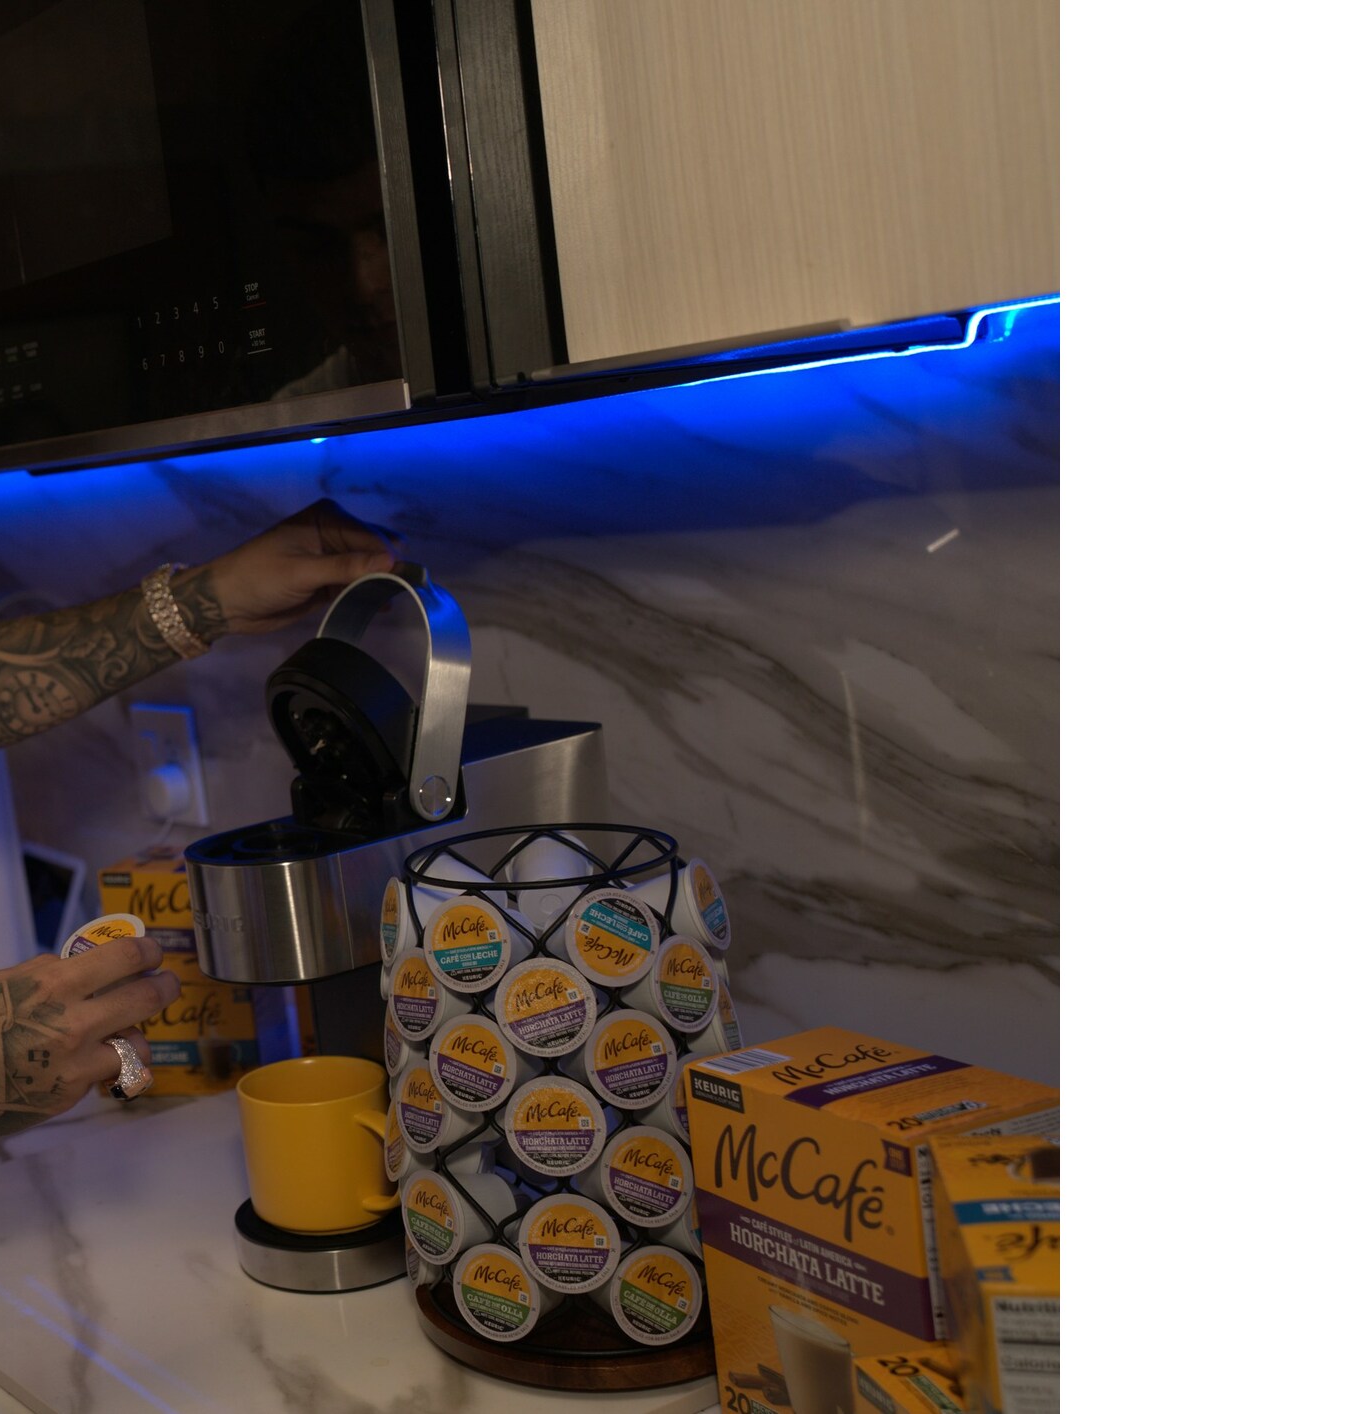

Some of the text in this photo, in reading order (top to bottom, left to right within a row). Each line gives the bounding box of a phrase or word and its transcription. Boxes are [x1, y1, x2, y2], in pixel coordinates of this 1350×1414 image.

[244, 282, 258, 293] STOP
[137, 296, 219, 328] 1 2 3 4 5
[249, 328, 265, 339] START
[142, 341, 224, 370] 6 7 8 9 0
[443, 916, 487, 942] McCafé
[589, 909, 616, 927] LECHE
[440, 954, 459, 964] CAFÉ
[472, 950, 498, 959] LECHE
[584, 936, 634, 966] McCafé
[401, 970, 429, 990] McCafé
[667, 958, 704, 980] McCafé
[515, 977, 564, 1012] McCafé
[519, 1016, 560, 1035] HORCHATA
[560, 1009, 585, 1021] LATTE
[452, 1036, 498, 1063] McCafé
[604, 1029, 649, 1060] McCafé
[441, 1063, 476, 1082] HORCHATA
[477, 1076, 498, 1090] LATTE
[605, 1068, 643, 1083] HORCHATA
[643, 1062, 665, 1073] LATTE
[772, 1044, 892, 1086] McCafé
[408, 1081, 435, 1103] McCafé
[693, 1077, 740, 1103] KEURIG
[822, 1072, 896, 1096] HORCHATA
[893, 1063, 938, 1078] LATTE
[526, 1101, 578, 1122] McCafé
[887, 1118, 922, 1130] 20
[523, 1137, 590, 1145] HORCHATA LATTE
[623, 1149, 673, 1176] McCafé
[614, 1176, 652, 1196] HORCHATA
[652, 1189, 675, 1204] LATTE
[714, 1123, 884, 1243] McCafé
[541, 1217, 594, 1240] McCafé
[752, 1218, 768, 1232] CAFÉ
[769, 1225, 793, 1243] STYLES
[799, 1238, 820, 1253] LATIN
[820, 1245, 853, 1267] AMERICA
[536, 1252, 604, 1264] HORCHATA LATTE
[729, 1222, 822, 1279] HORCHATA
[824, 1263, 886, 1307] LATTE
[474, 1265, 522, 1292] McCafé
[637, 1264, 684, 1296] McCafé
[501, 1304, 523, 1319] OLLA
[654, 1306, 677, 1324] OLLA
[725, 1386, 751, 1414] 20
